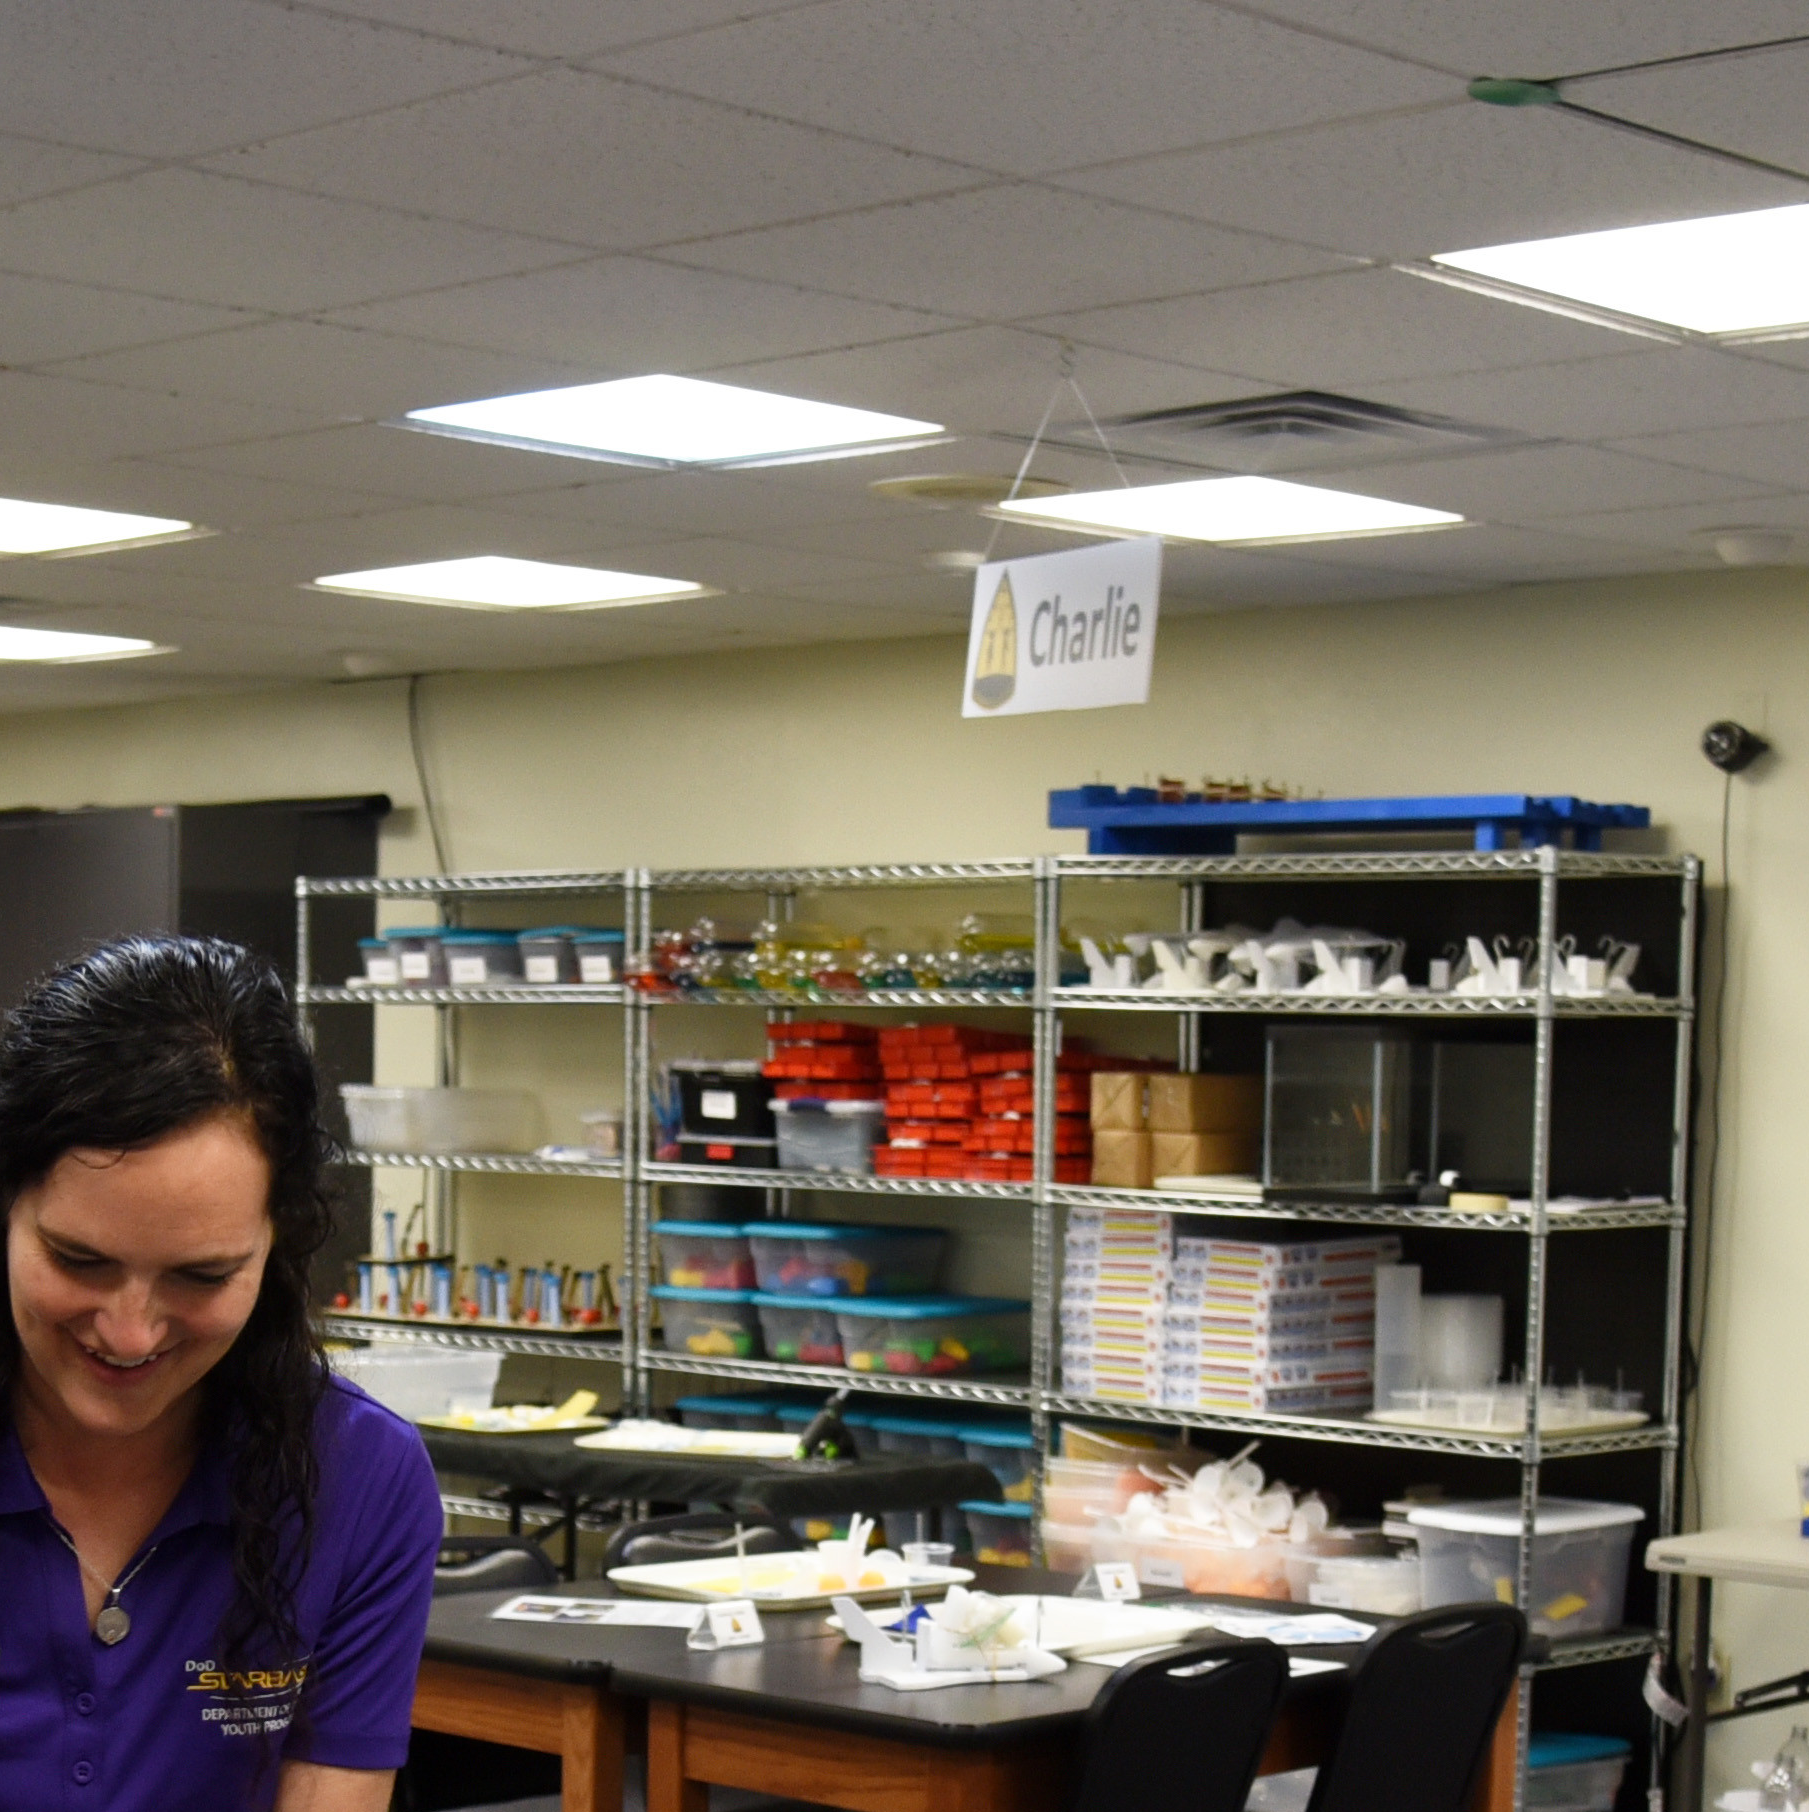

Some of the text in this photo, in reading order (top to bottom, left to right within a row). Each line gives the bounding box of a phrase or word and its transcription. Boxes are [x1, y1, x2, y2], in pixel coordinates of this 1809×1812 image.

[1029, 585, 1142, 668] Charlie
[185, 1659, 216, 1672] DoD
[220, 1722, 263, 1736] YOUTH
